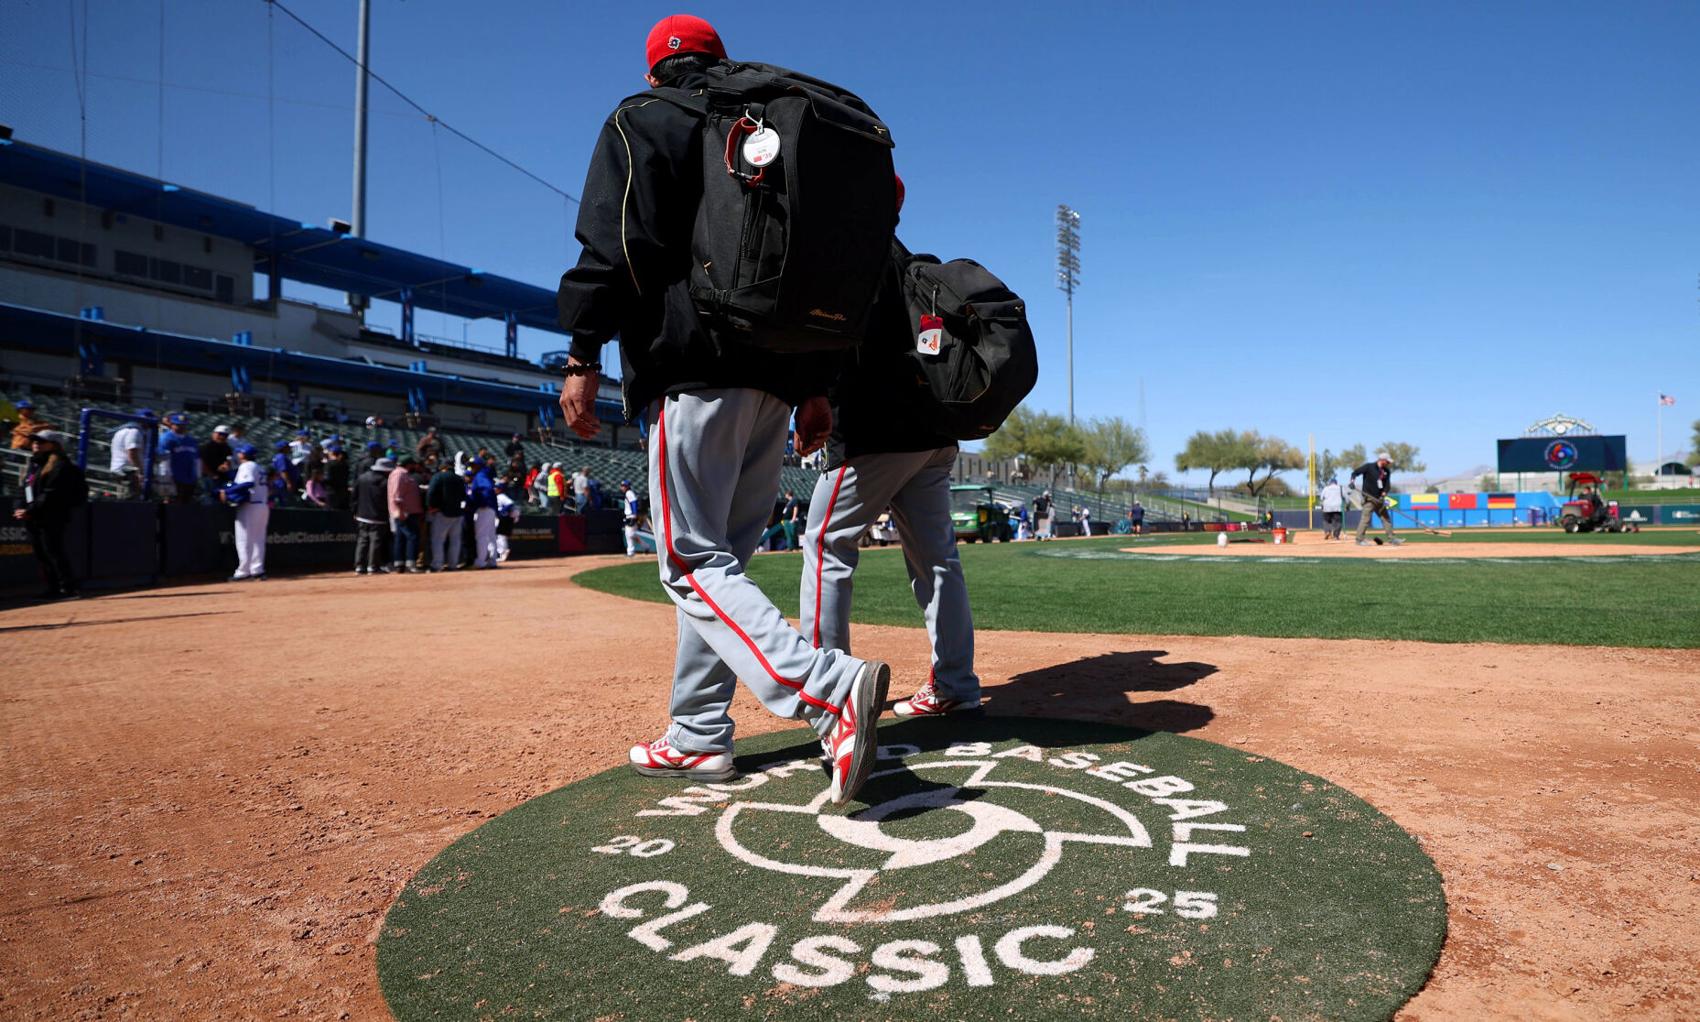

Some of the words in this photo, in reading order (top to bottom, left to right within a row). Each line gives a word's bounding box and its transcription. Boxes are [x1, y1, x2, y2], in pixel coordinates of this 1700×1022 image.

[635, 744, 921, 817] WORD
[944, 741, 1250, 867] BASEBALL
[590, 834, 676, 858] 20
[598, 880, 1095, 993] CLASSIC
[1122, 887, 1219, 920] 25
